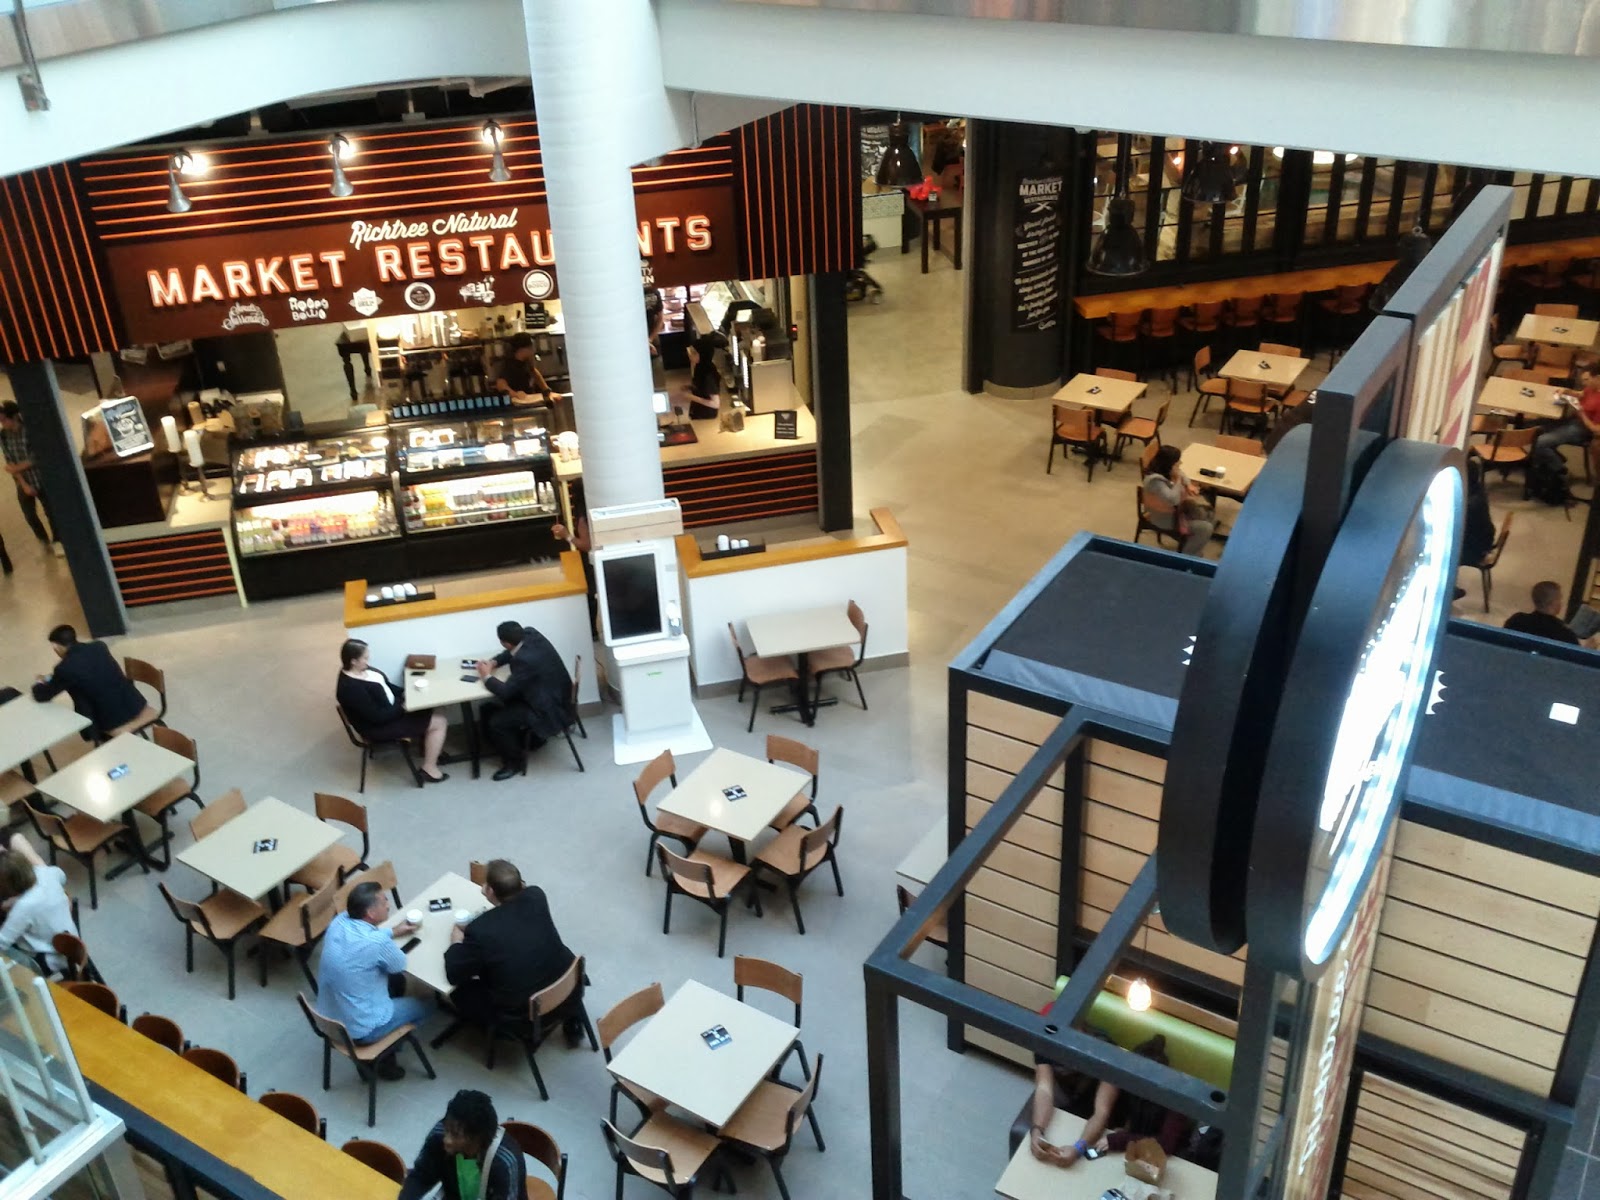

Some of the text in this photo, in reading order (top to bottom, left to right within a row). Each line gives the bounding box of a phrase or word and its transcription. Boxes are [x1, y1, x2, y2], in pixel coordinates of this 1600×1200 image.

[1019, 180, 1063, 196] MARKET
[349, 207, 519, 250] Richtree Natural
[147, 214, 712, 308] MARKET RESTAUNTS
